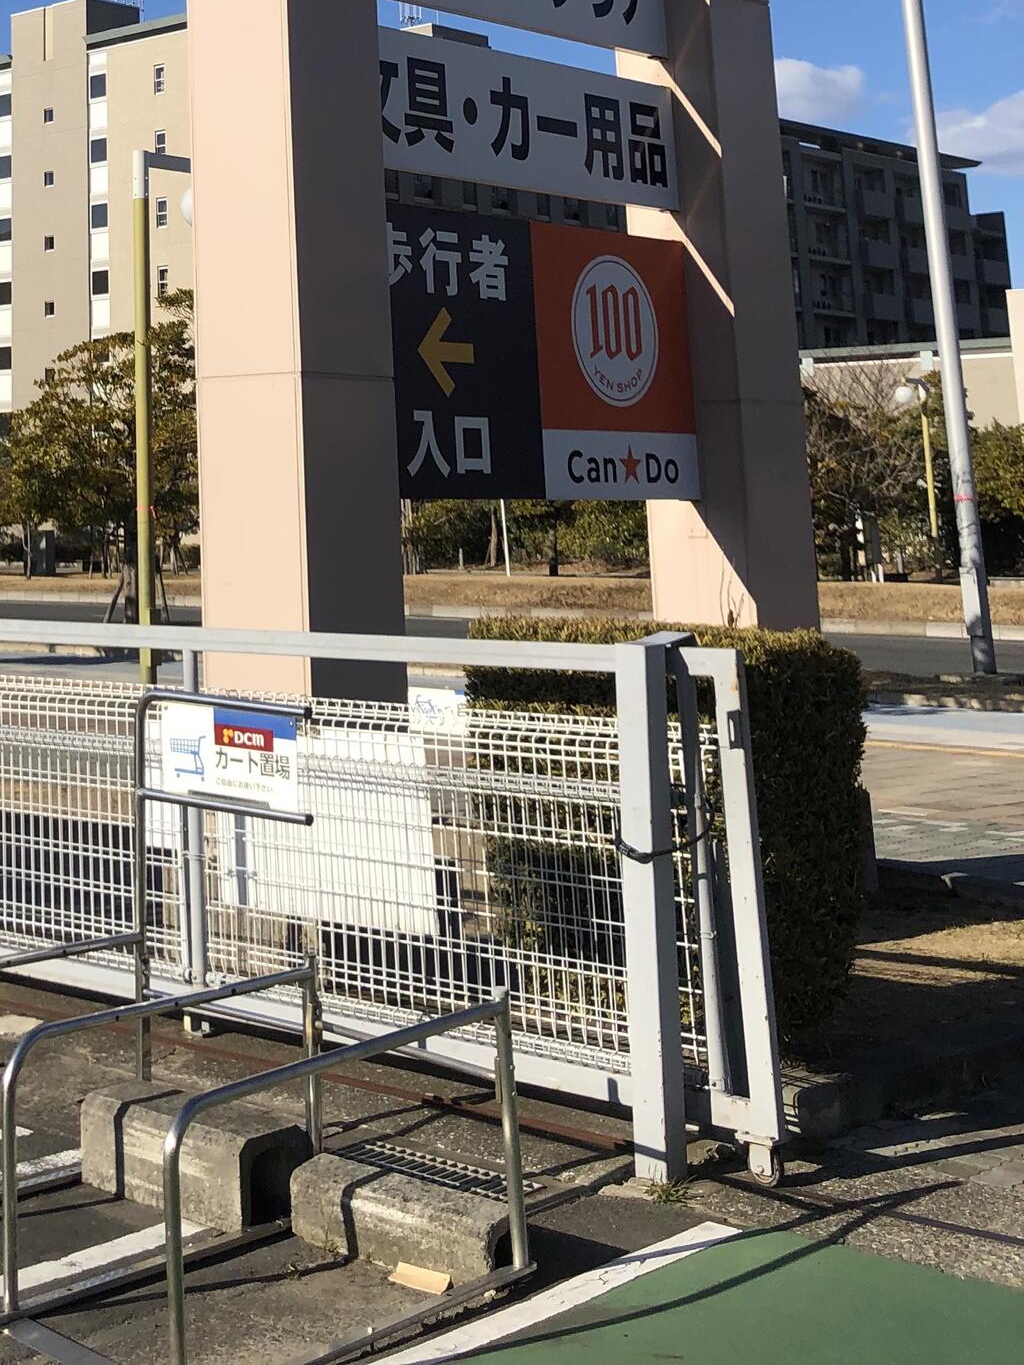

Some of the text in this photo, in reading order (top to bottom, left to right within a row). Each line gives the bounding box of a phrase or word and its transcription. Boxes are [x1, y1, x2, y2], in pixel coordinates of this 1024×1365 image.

[586, 282, 643, 362] 100
[592, 363, 644, 394] YEN SHOP
[406, 409, 493, 479] 入口
[216, 748, 290, 780] カート置場
